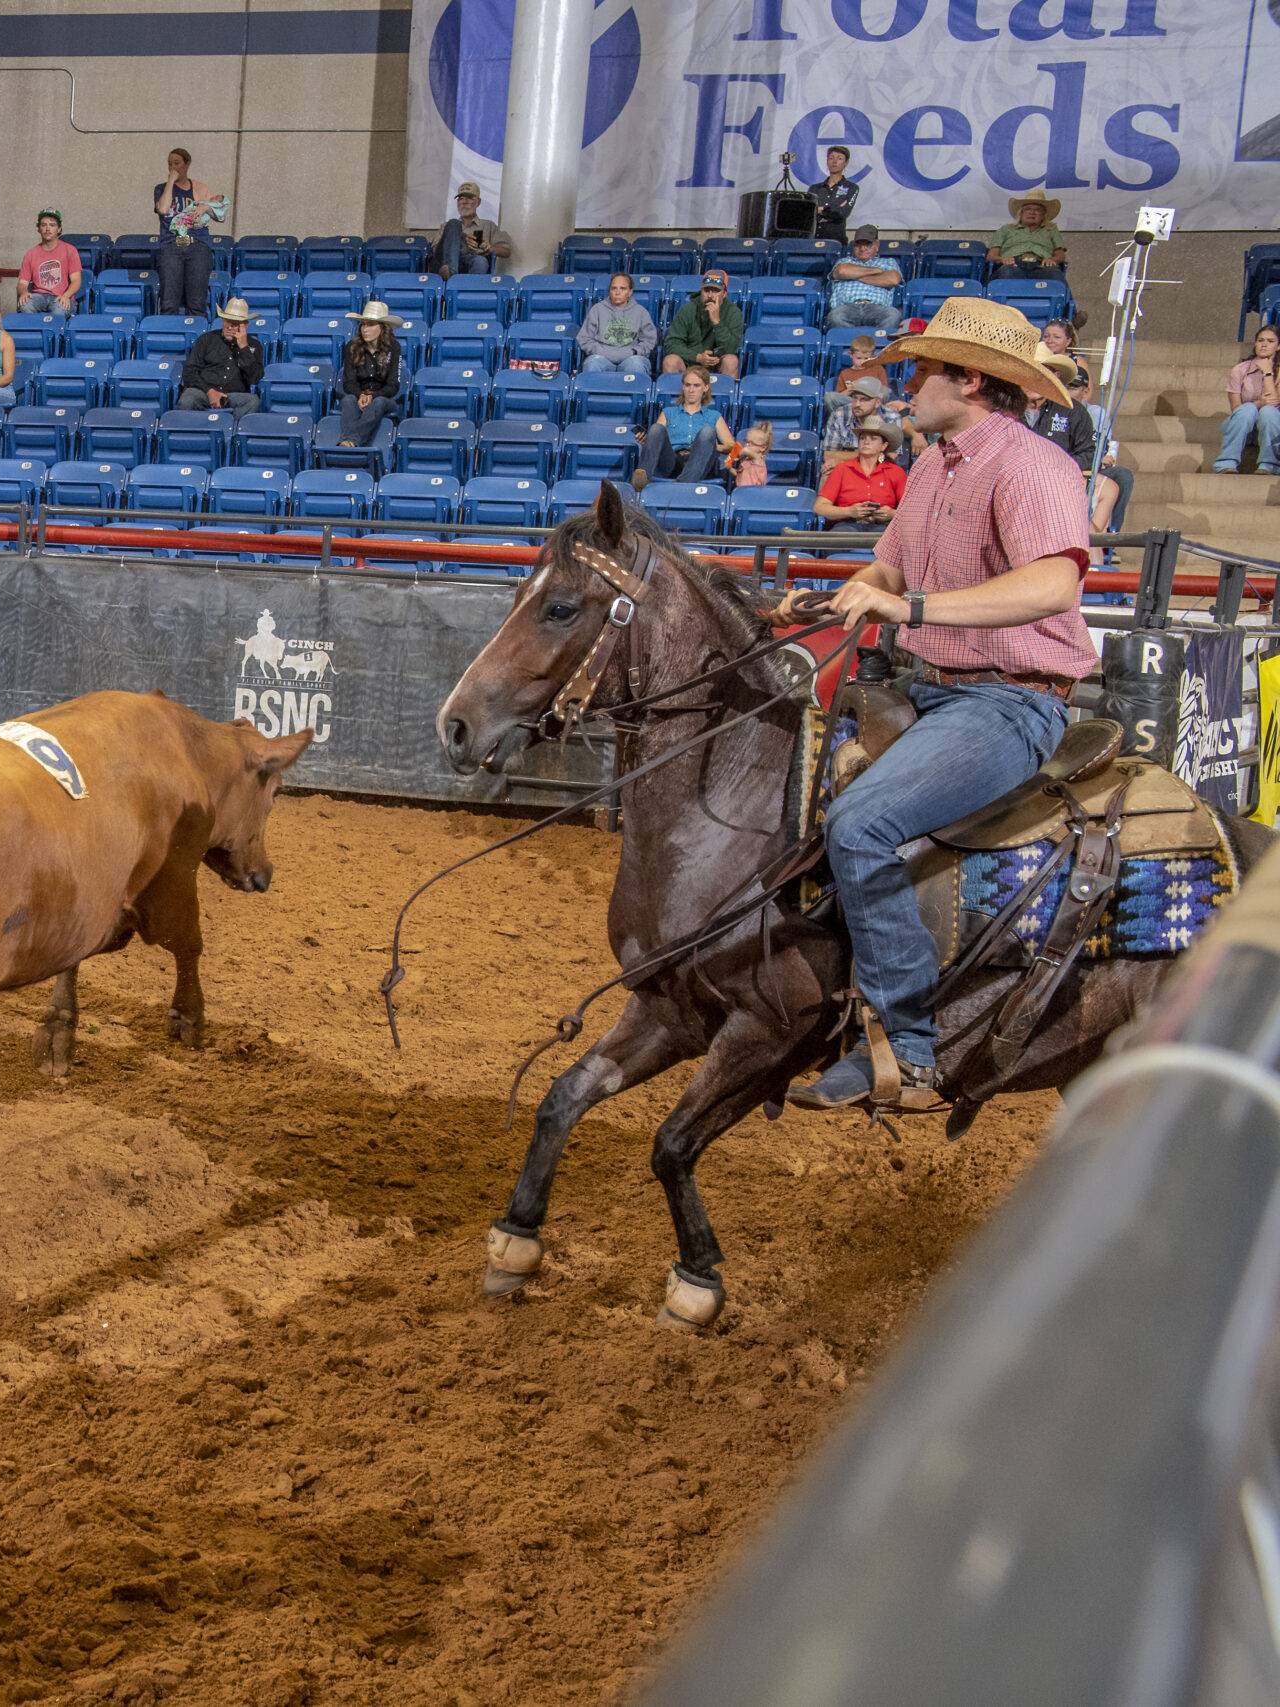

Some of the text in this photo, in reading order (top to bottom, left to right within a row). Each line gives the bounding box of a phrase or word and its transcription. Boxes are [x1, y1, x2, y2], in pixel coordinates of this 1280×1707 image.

[675, 61, 1181, 192] Feeds
[288, 639, 335, 651] CINCH
[1141, 641, 1164, 675] R
[234, 687, 332, 743] RSNC
[1135, 718, 1158, 753] S
[26, 738, 83, 795] 9
